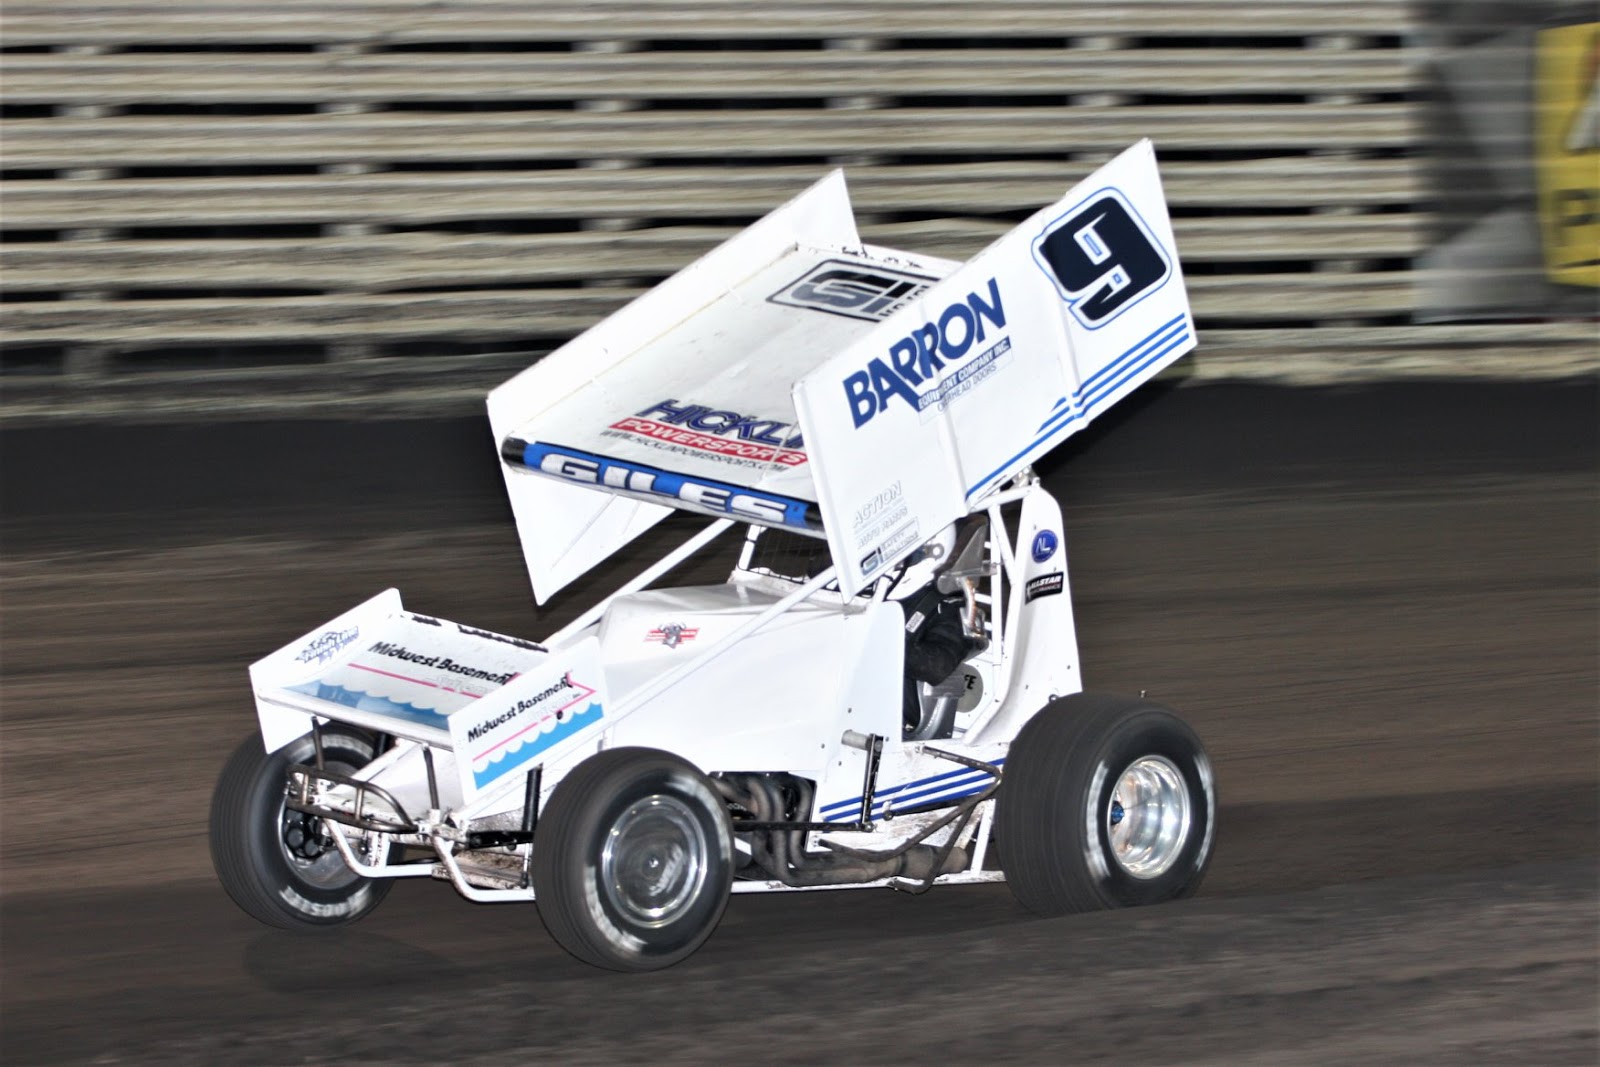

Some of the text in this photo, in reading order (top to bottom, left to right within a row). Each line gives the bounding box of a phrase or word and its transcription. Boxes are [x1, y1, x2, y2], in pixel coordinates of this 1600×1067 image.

[1036, 194, 1169, 322] 9
[842, 277, 1006, 429] BARRON
[616, 418, 806, 464] POWERSPORTS
[633, 399, 804, 449] HICKLI
[540, 453, 787, 522] GILES
[367, 640, 439, 668] Midwest
[467, 706, 517, 743] Midwest
